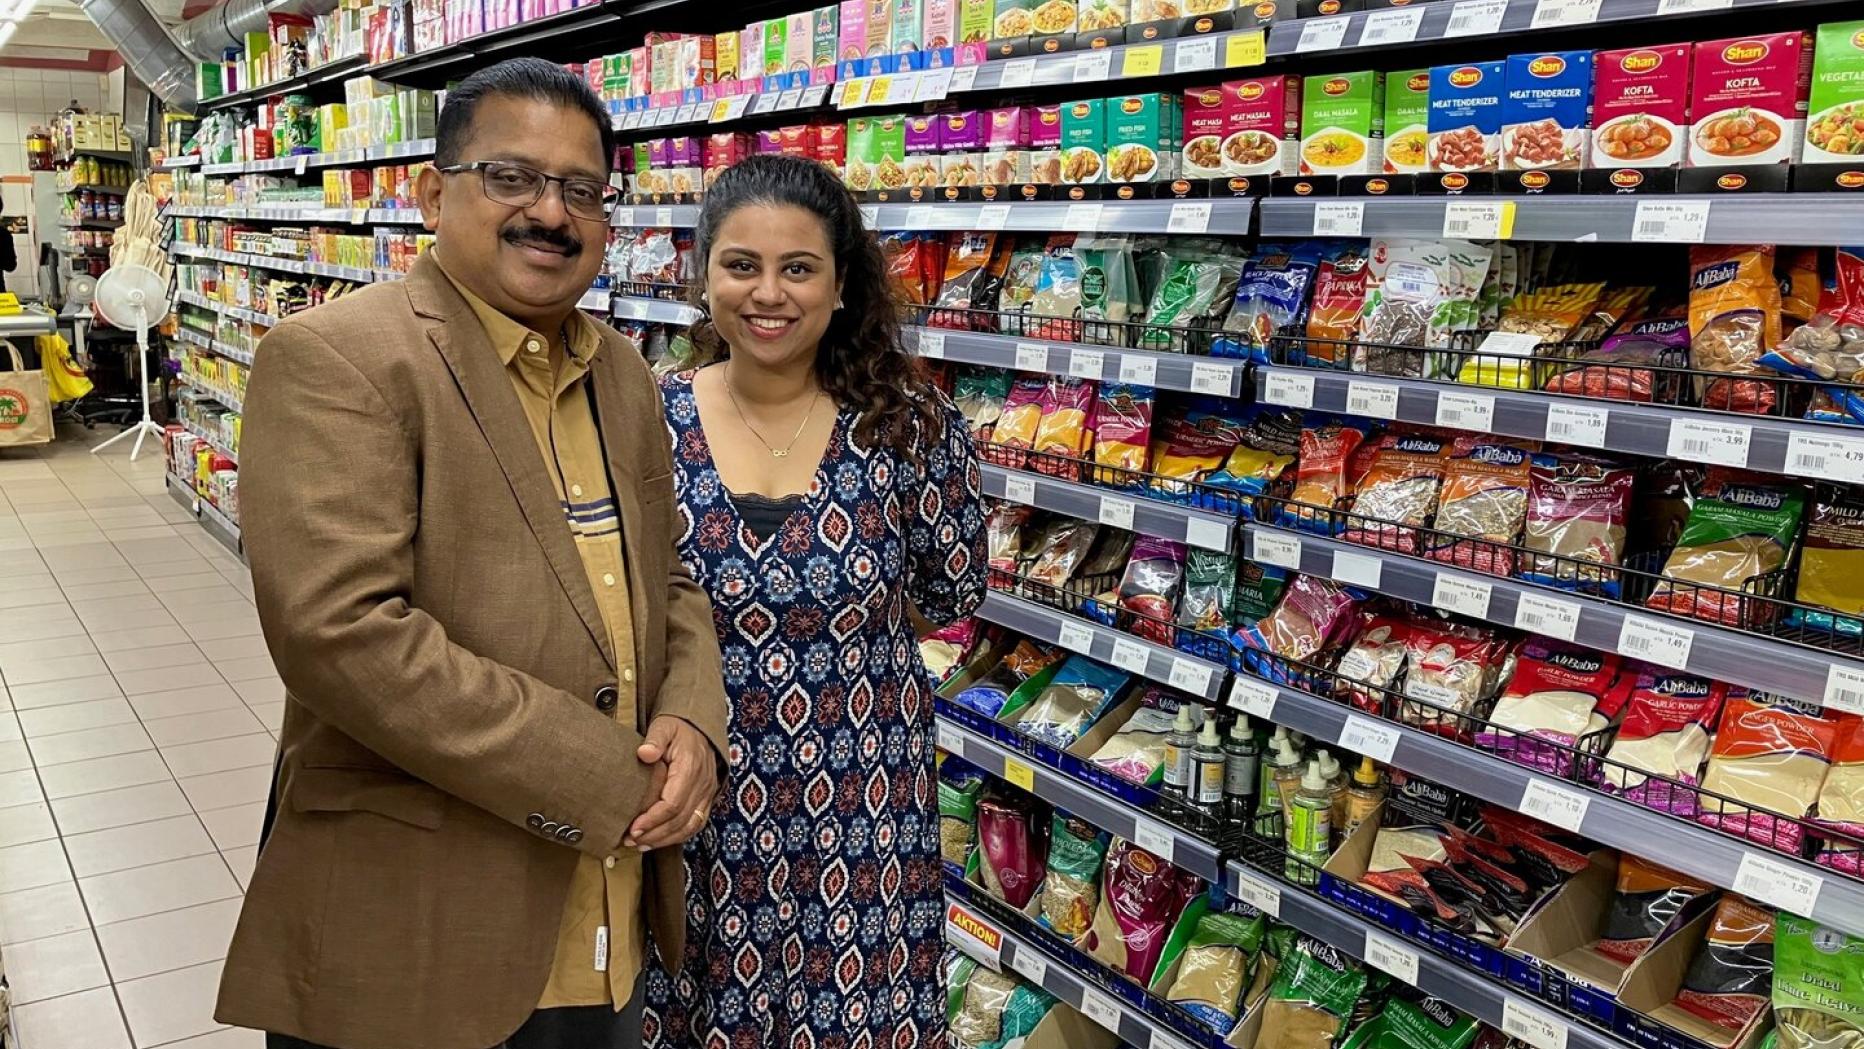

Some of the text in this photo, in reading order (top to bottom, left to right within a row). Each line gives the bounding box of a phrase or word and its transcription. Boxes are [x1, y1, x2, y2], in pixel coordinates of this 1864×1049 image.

[1726, 46, 1763, 61] Shan
[1532, 61, 1561, 73] Shan
[1624, 57, 1656, 69] Shan
[1409, 79, 1430, 88] Sha
[1452, 72, 1478, 83] Shan
[1725, 77, 1760, 89] KOFTA
[1325, 82, 1347, 91] Shan
[1623, 85, 1654, 96] KOFTA
[1509, 88, 1581, 99] MEAT TENDERIZER
[1432, 97, 1498, 108] MEAT TENDERIZER
[1230, 112, 1271, 122] MEAT MASALA
[1331, 108, 1358, 117] MASALA
[1443, 177, 1465, 186] Shan
[1524, 175, 1546, 185] Shan
[1614, 173, 1639, 183] Shan
[1720, 178, 1743, 187] Shan
[1725, 434, 1743, 446] 3,99
[1399, 440, 1440, 453] AliBaba
[1477, 445, 1522, 464] AliBaba
[1722, 486, 1782, 508] AliBaba
[1549, 653, 1600, 672] AliBaba
[1659, 678, 1708, 695] AliBaba
[1407, 782, 1447, 803] AliBaba
[953, 912, 997, 947] AKTION!
[1801, 971, 1842, 993] Dried
[1777, 978, 1812, 1001] Lime
